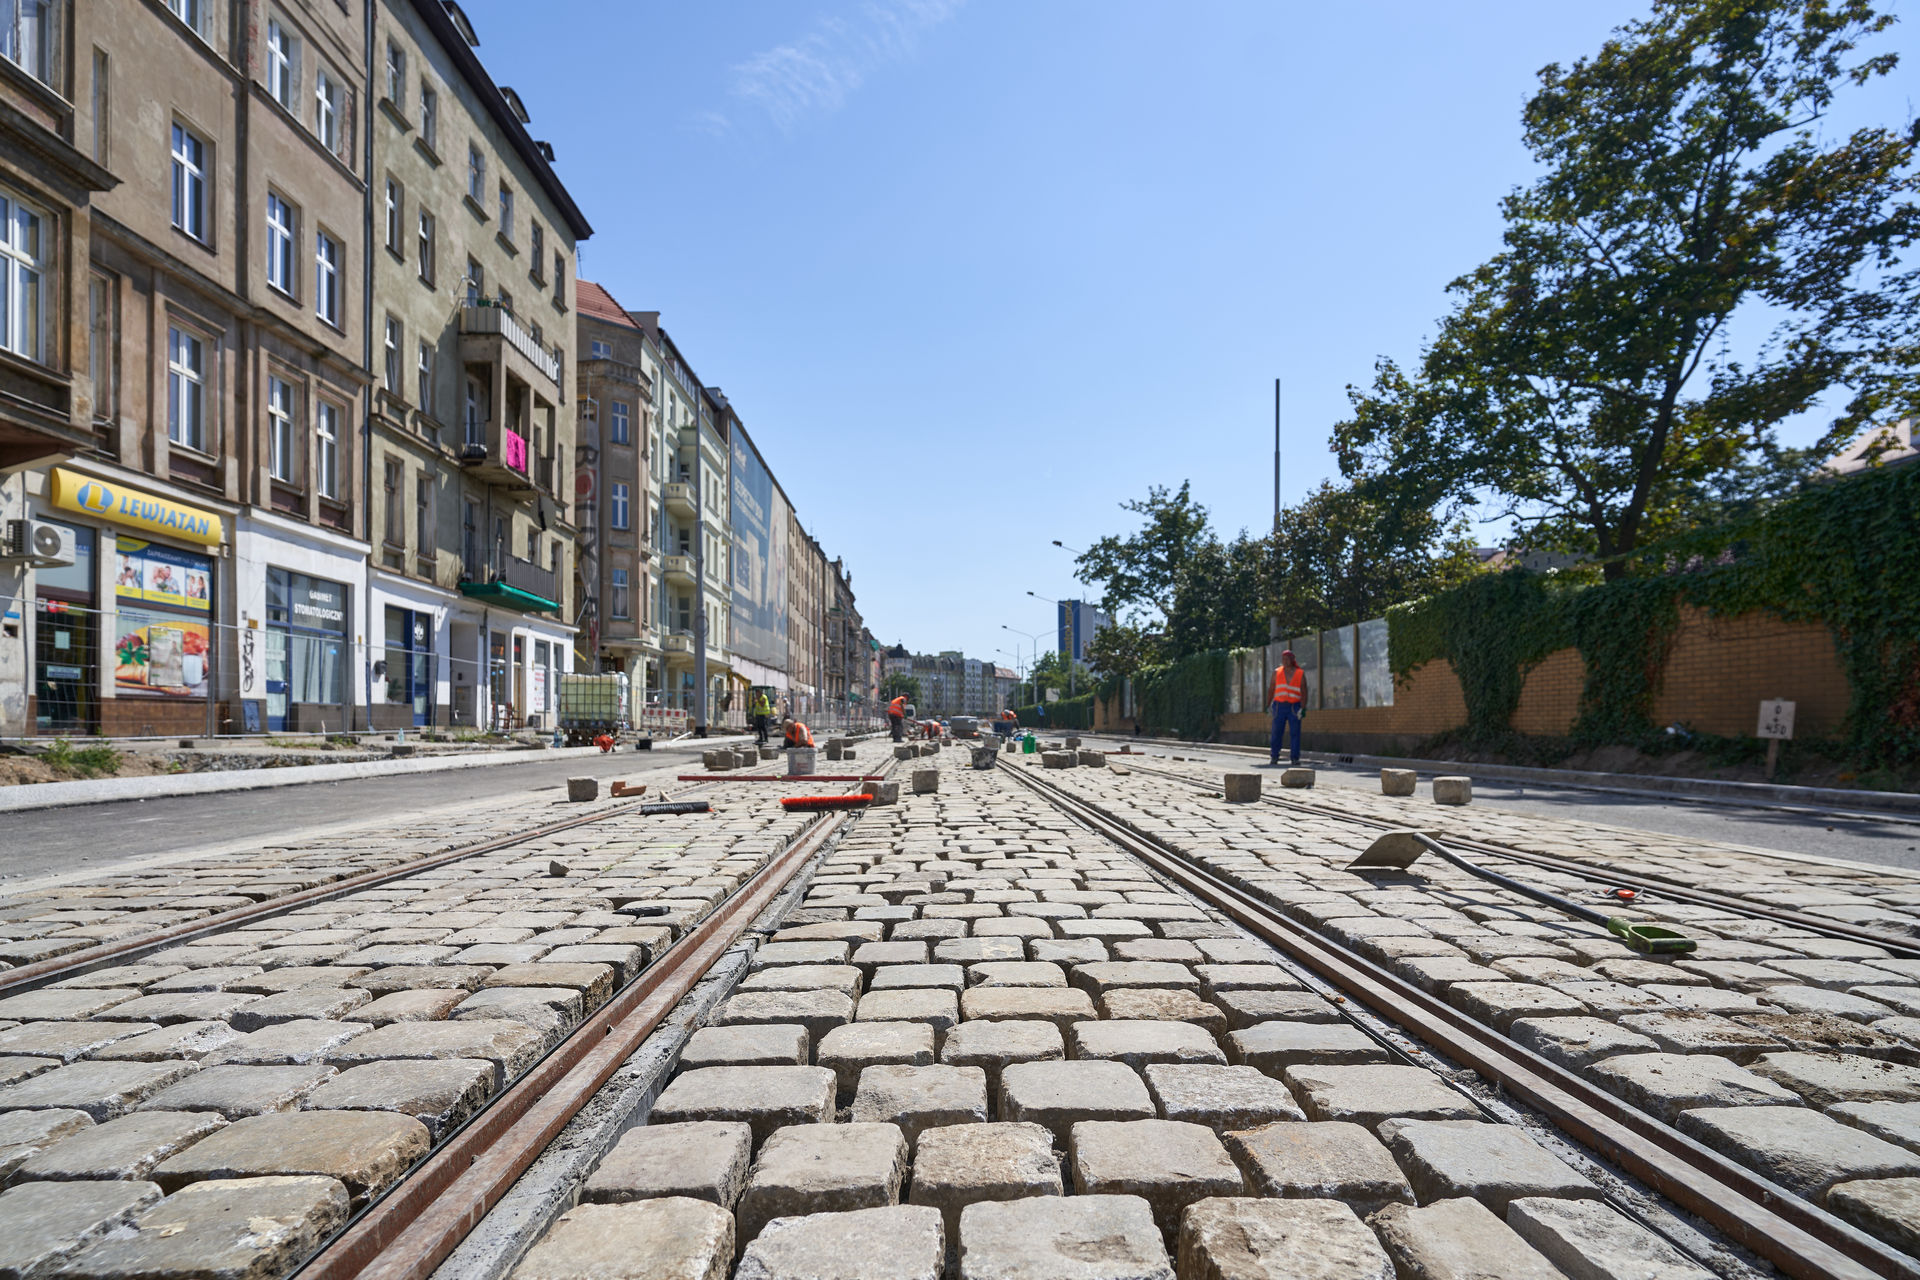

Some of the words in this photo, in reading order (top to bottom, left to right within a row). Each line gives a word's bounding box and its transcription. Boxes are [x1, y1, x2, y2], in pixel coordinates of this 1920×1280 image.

[85, 481, 106, 513] L
[119, 496, 210, 536] LEWIATAN
[309, 590, 333, 603] GABINET
[294, 603, 344, 621] STOMATOLOGICZNY
